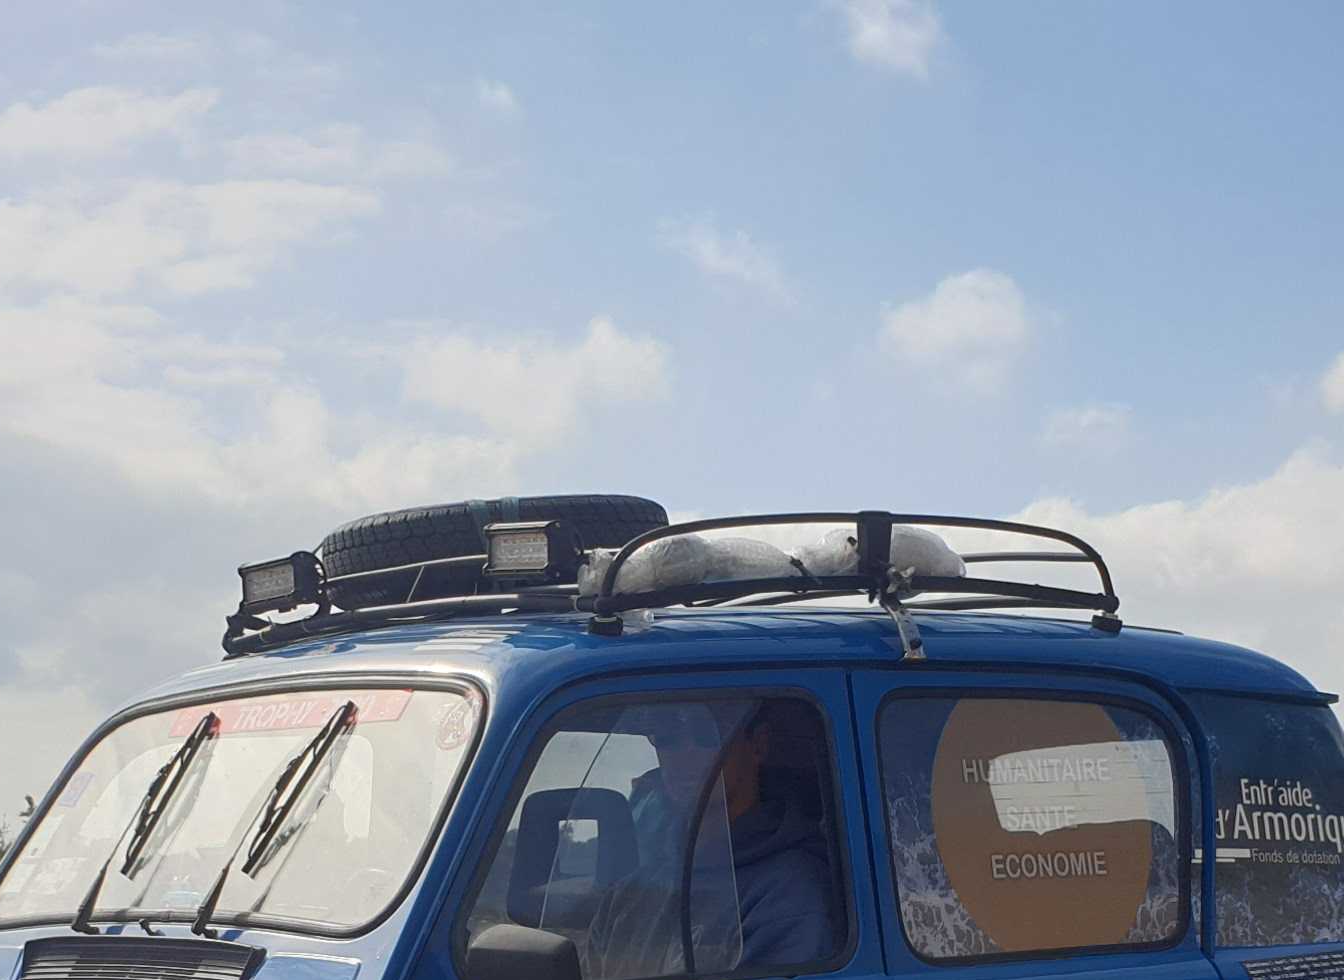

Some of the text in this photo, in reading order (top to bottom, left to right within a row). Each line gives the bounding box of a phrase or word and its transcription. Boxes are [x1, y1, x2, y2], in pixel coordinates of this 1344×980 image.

[962, 757, 1111, 784] HUMANITAIRE
[992, 851, 1107, 879] ECONOMIE
[1252, 848, 1285, 863] Fonds
[1286, 849, 1300, 863] de
